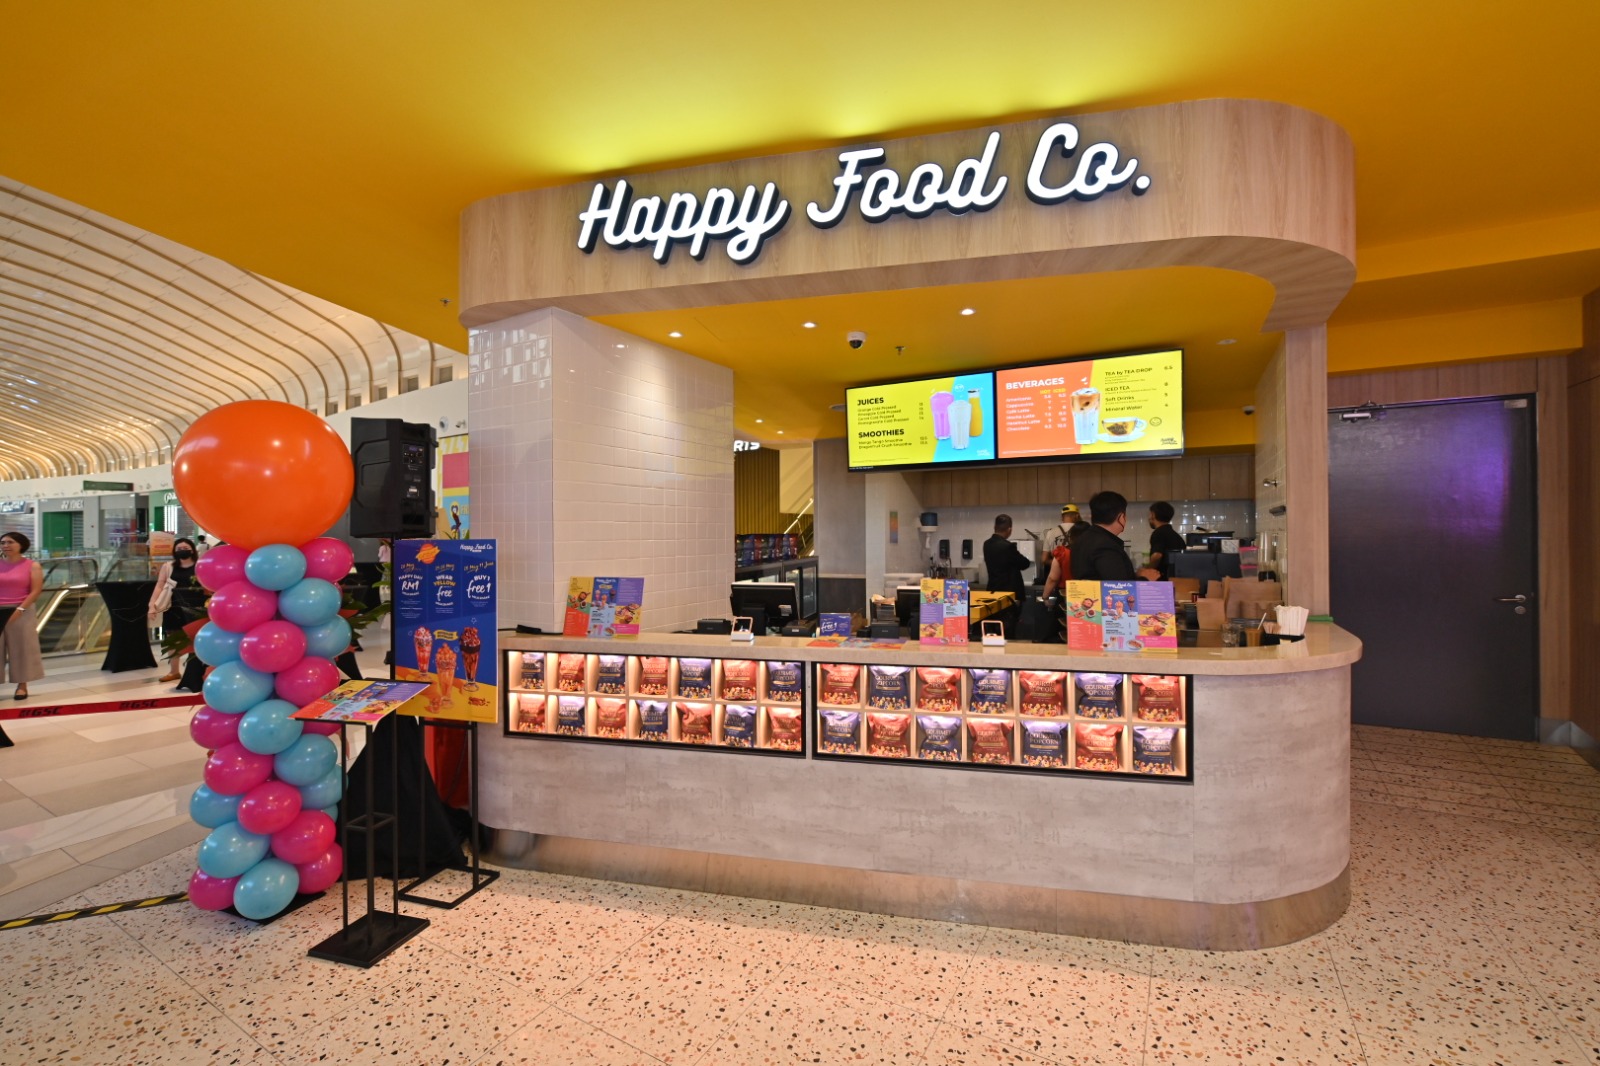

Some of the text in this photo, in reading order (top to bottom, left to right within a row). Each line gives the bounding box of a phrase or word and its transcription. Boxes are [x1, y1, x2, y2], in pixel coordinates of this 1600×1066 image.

[578, 122, 1151, 263] Happy Food Co.
[1006, 377, 1065, 390] BEVERAGES
[857, 397, 884, 406] JUICES
[858, 428, 904, 439] SMOOTHIES
[402, 580, 419, 591] RM1
[466, 580, 485, 598] free
[436, 585, 453, 601] free
